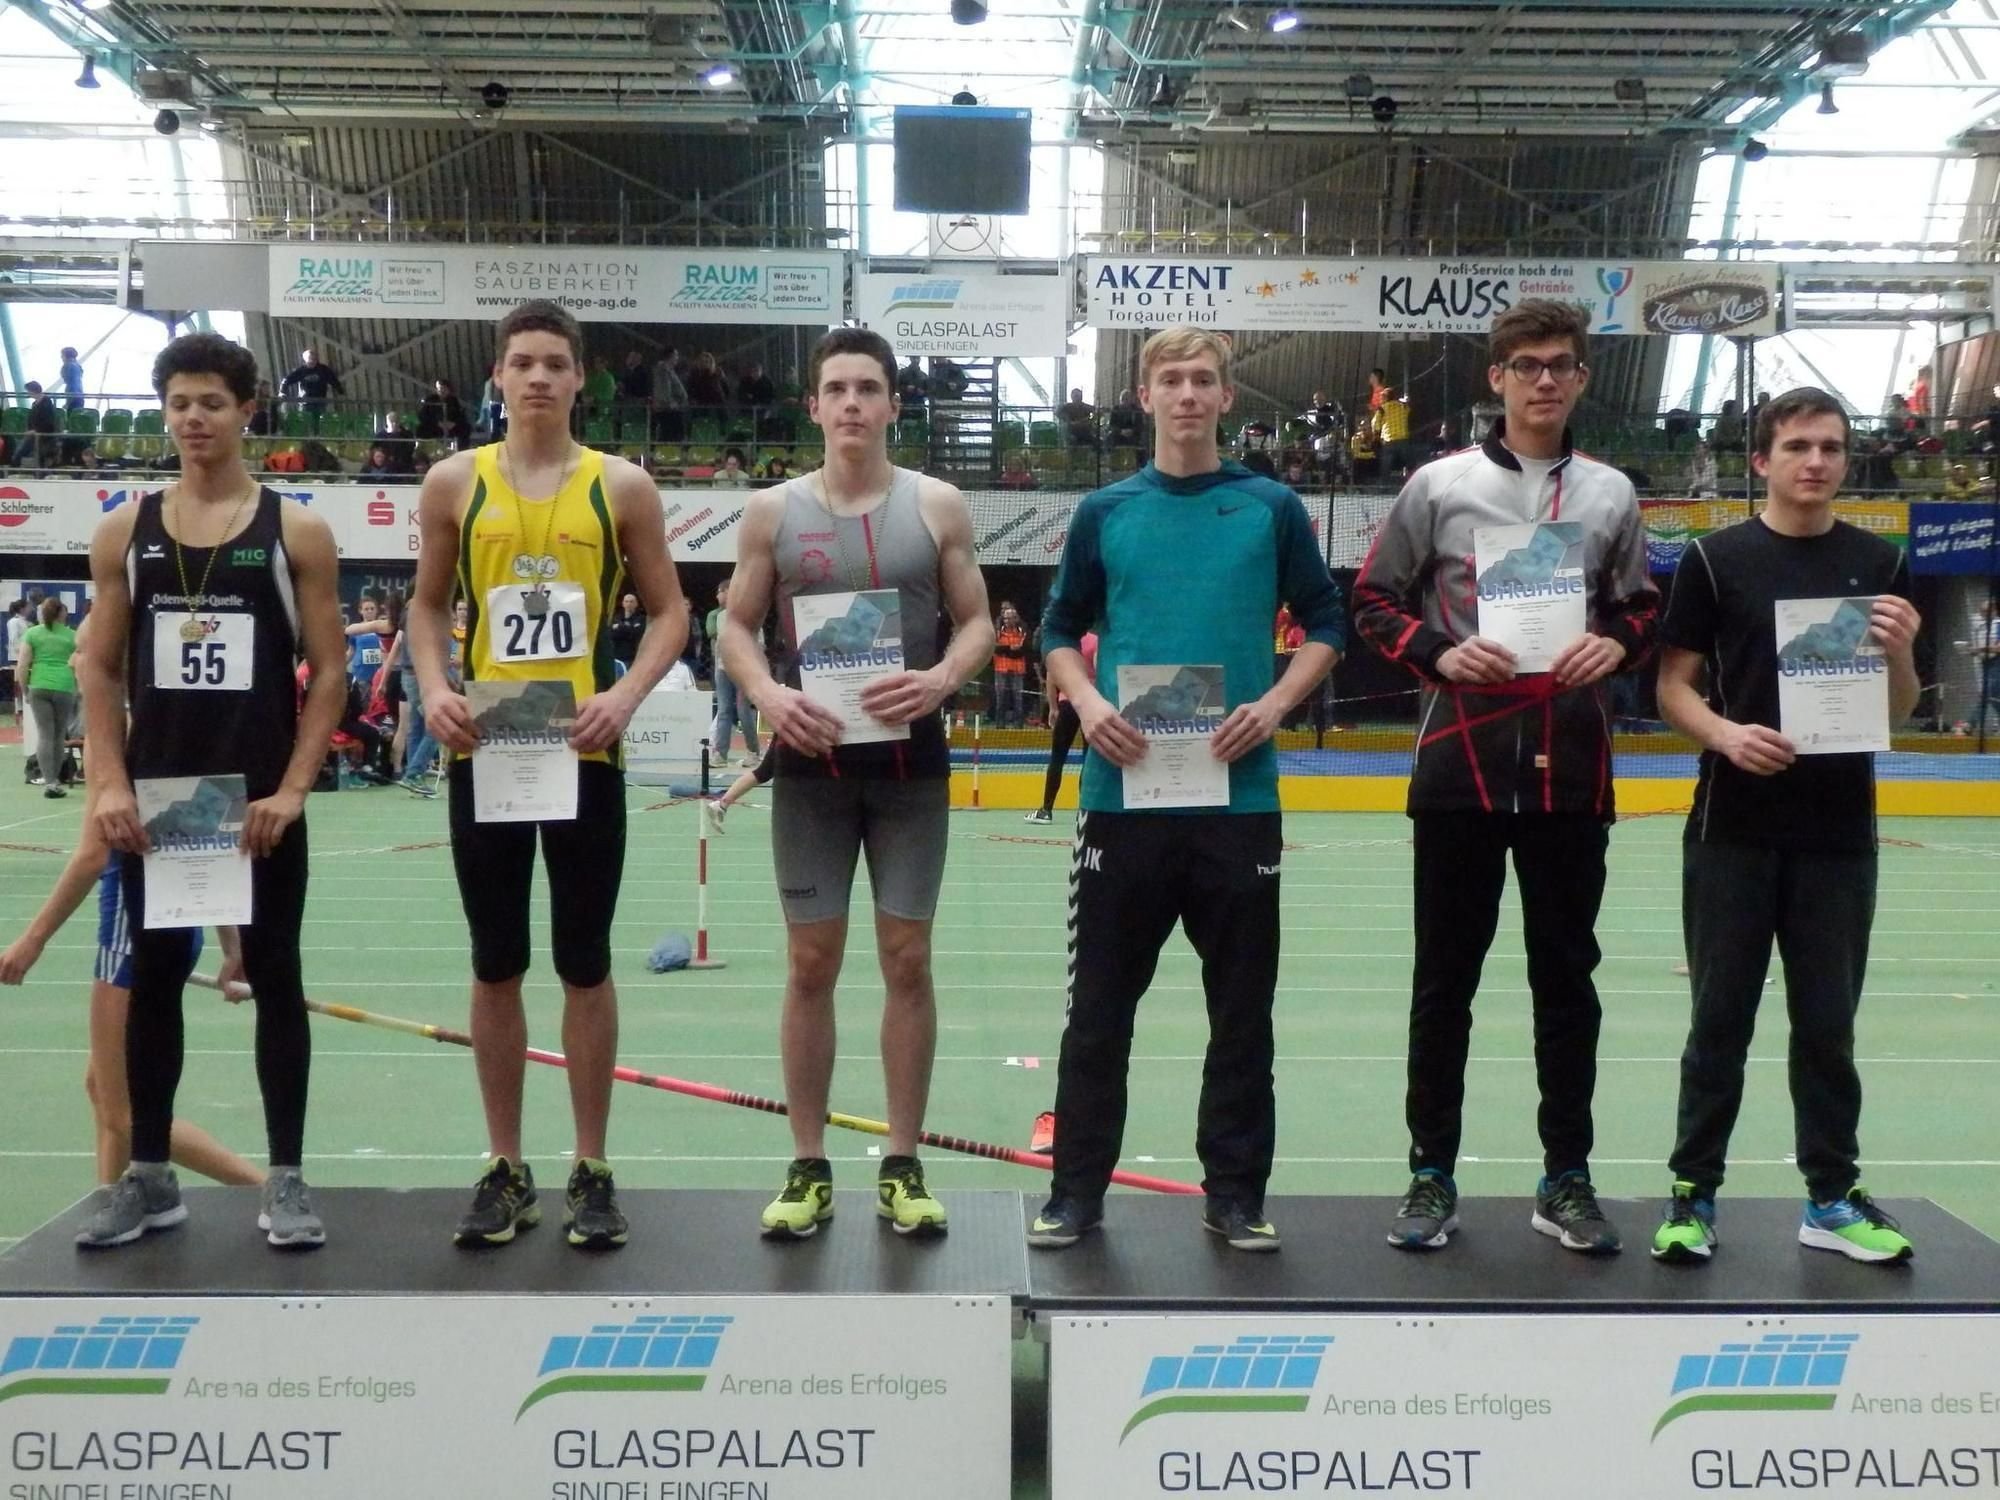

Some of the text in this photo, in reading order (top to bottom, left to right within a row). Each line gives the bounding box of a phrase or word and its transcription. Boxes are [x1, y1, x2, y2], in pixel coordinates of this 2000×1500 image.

[299, 258, 373, 278] RAUM
[388, 266, 401, 274] Wir
[475, 261, 638, 276] FASZINATION
[686, 265, 758, 284] RAUM
[773, 273, 788, 281] Wir
[1440, 263, 1574, 277] Profi-Service hoch drei
[284, 279, 372, 295] PFLEGE
[388, 276, 425, 286] uns über
[474, 277, 638, 291] SAUBERKEIT
[1095, 265, 1233, 291] AKZENT
[1519, 280, 1575, 294] Getränke
[388, 289, 411, 298] jeden
[671, 286, 757, 301] PFLEGE
[790, 283, 809, 292] über
[773, 295, 821, 304] jeden Dreck
[1111, 292, 1216, 307] HOTEL
[1379, 275, 1511, 319] KLAUSS
[1107, 309, 1218, 324] Torgauer Hof
[1650, 302, 1699, 333] Klauss
[1718, 295, 1765, 324] Klauss
[896, 321, 1019, 338] GLASPALAST
[1379, 320, 1491, 330] www.klauss.
[896, 340, 979, 351] SINDELFINGEN
[1, 501, 54, 514] Schlatterer
[1480, 577, 1583, 602] Urkunde
[503, 611, 574, 656] 270
[181, 642, 226, 684] 55
[801, 647, 901, 672] Urkunde
[1782, 656, 1884, 677] Urkunde
[184, 1376, 417, 1403] Arena des Erfolges
[720, 1374, 948, 1401] Arena des Erfolges
[1323, 1394, 1552, 1421] Arena des Erfolges
[1851, 1392, 1923, 1415] Arena
[1931, 1392, 1974, 1415] des
[12, 1431, 342, 1471] GLASPALAST
[553, 1430, 876, 1469] GLASPALAST
[1158, 1450, 1482, 1492] GLASPALAST
[1692, 1448, 2000, 1489] GLASPALAST
